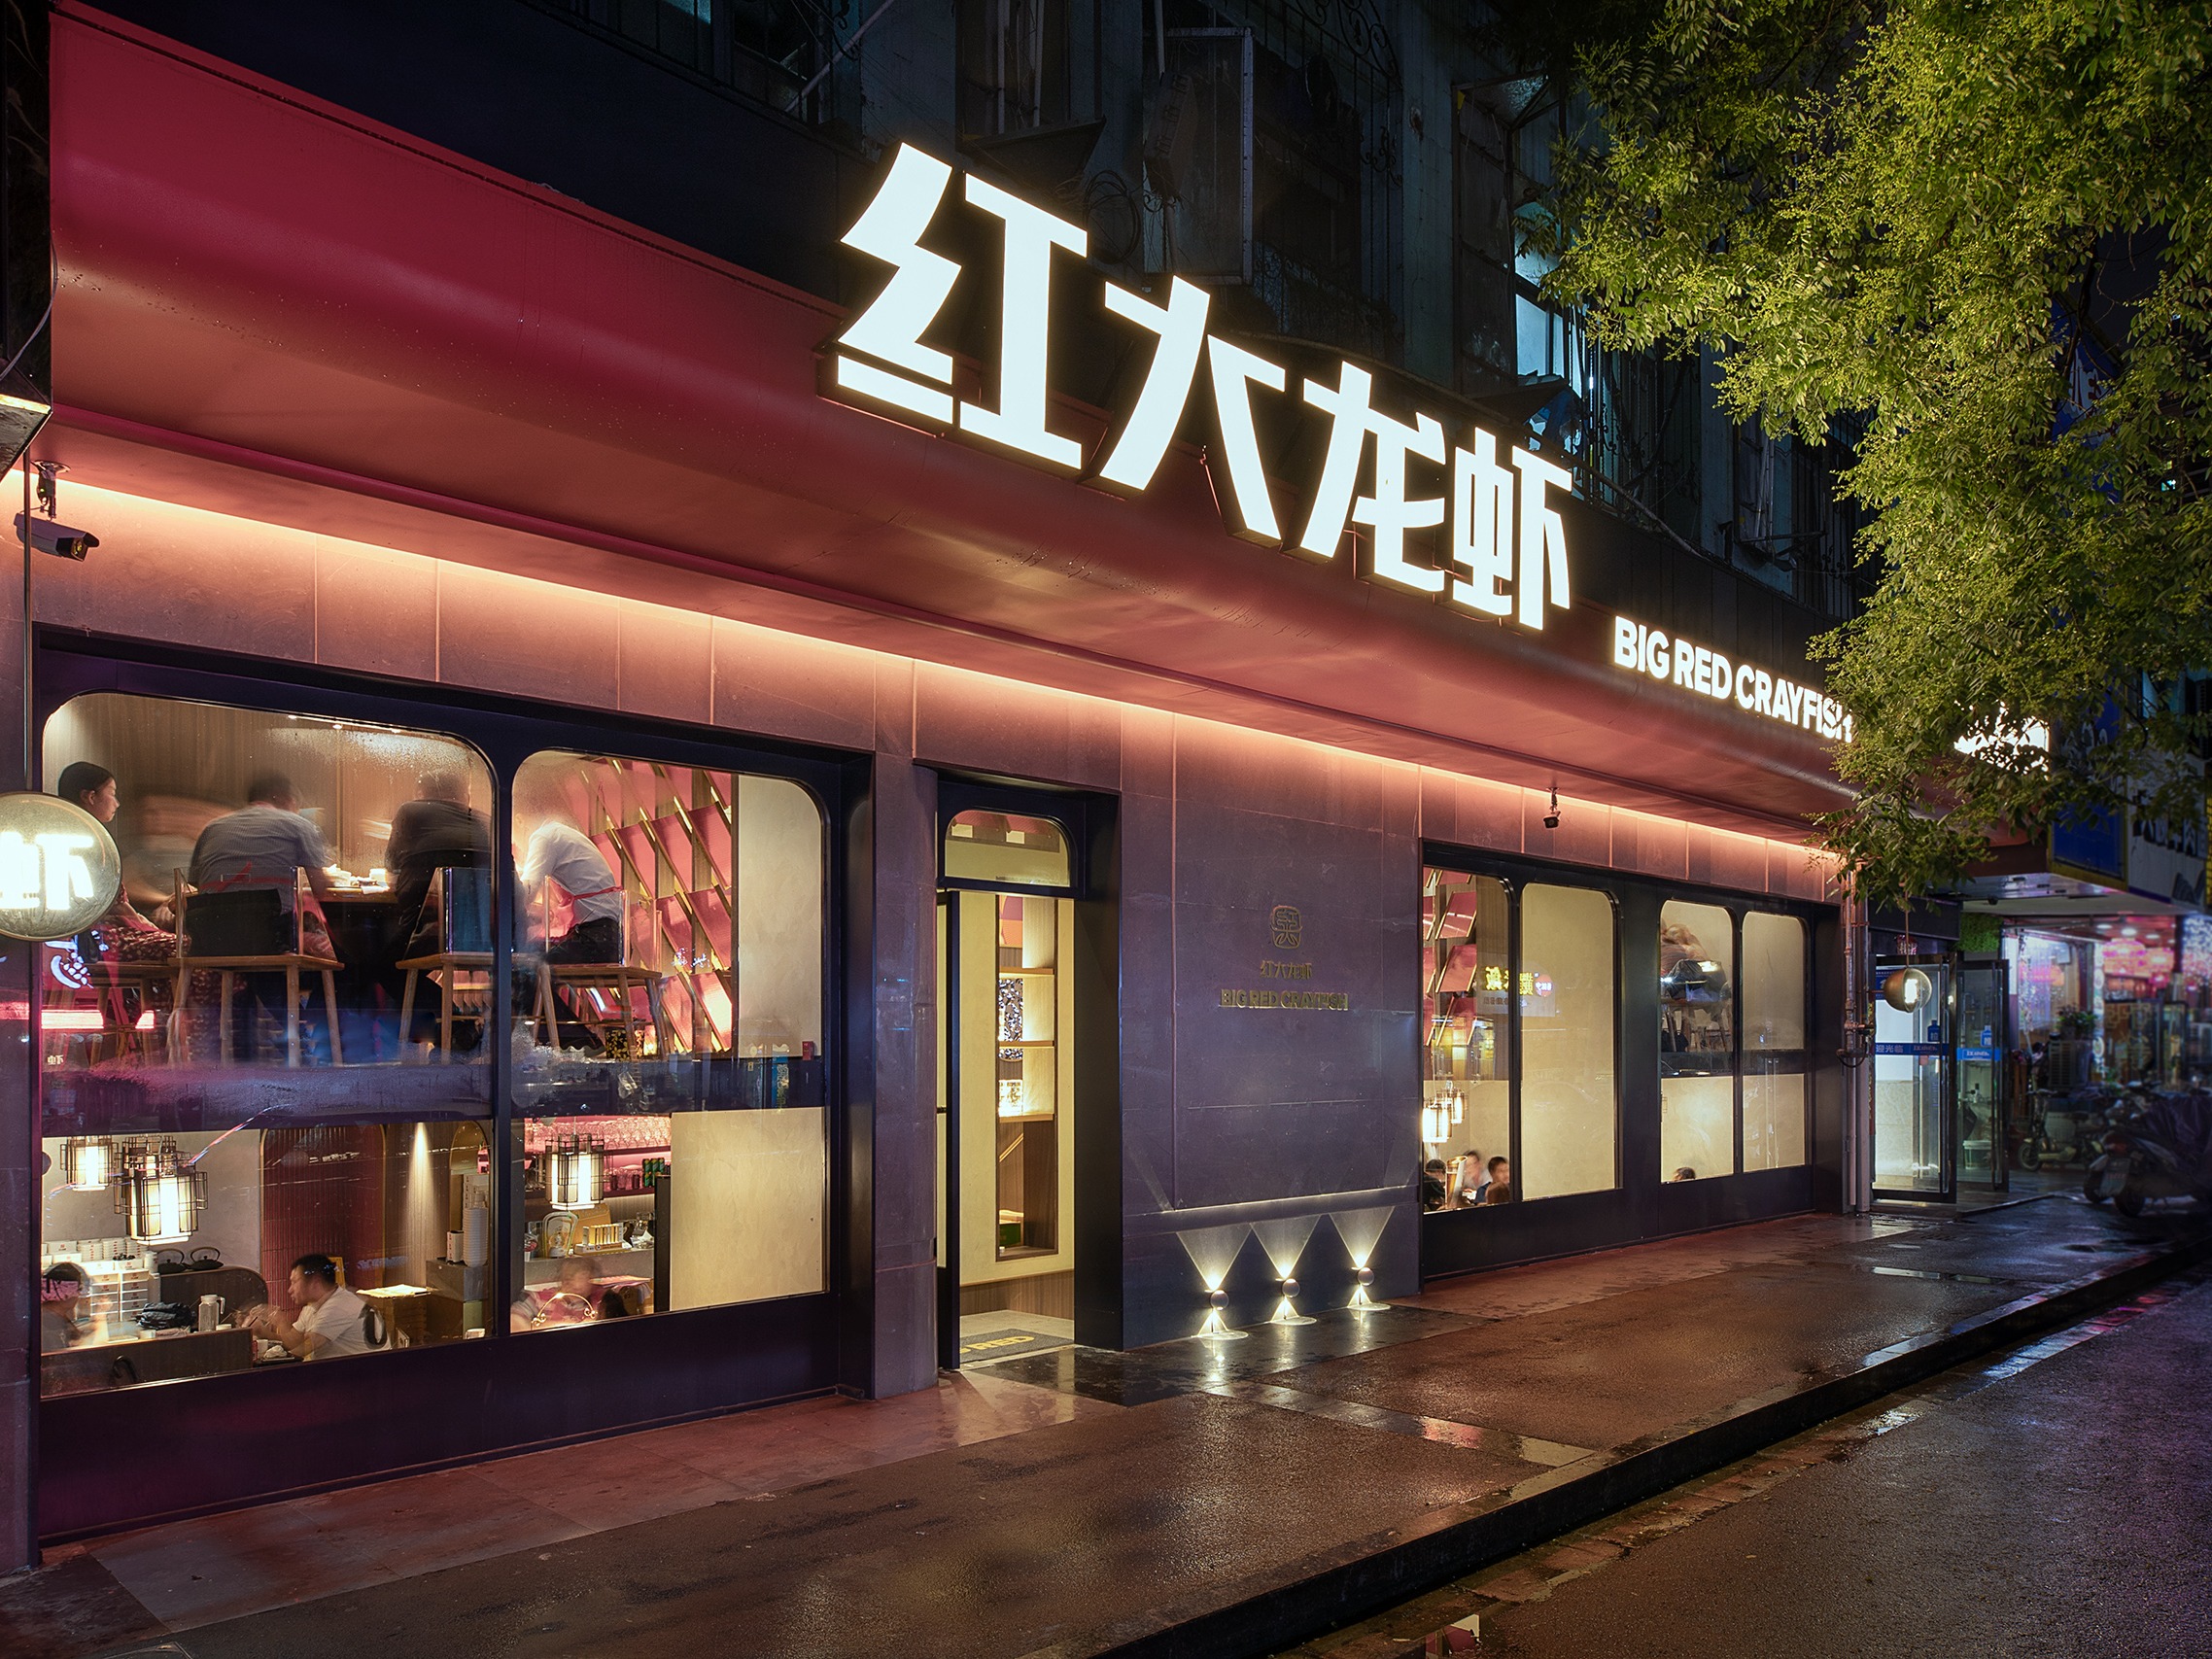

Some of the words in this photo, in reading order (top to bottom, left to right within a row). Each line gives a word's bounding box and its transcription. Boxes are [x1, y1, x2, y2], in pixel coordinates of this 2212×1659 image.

[837, 142, 1573, 630] 红大龙虾
[1614, 616, 1670, 678] BIG
[1674, 639, 1733, 700] RED
[1261, 960, 1312, 980] 红大龙虾
[1221, 989, 1248, 1008] BIG
[1249, 990, 1278, 1008] RED
[1281, 991, 1348, 1011] CRAYFISH
